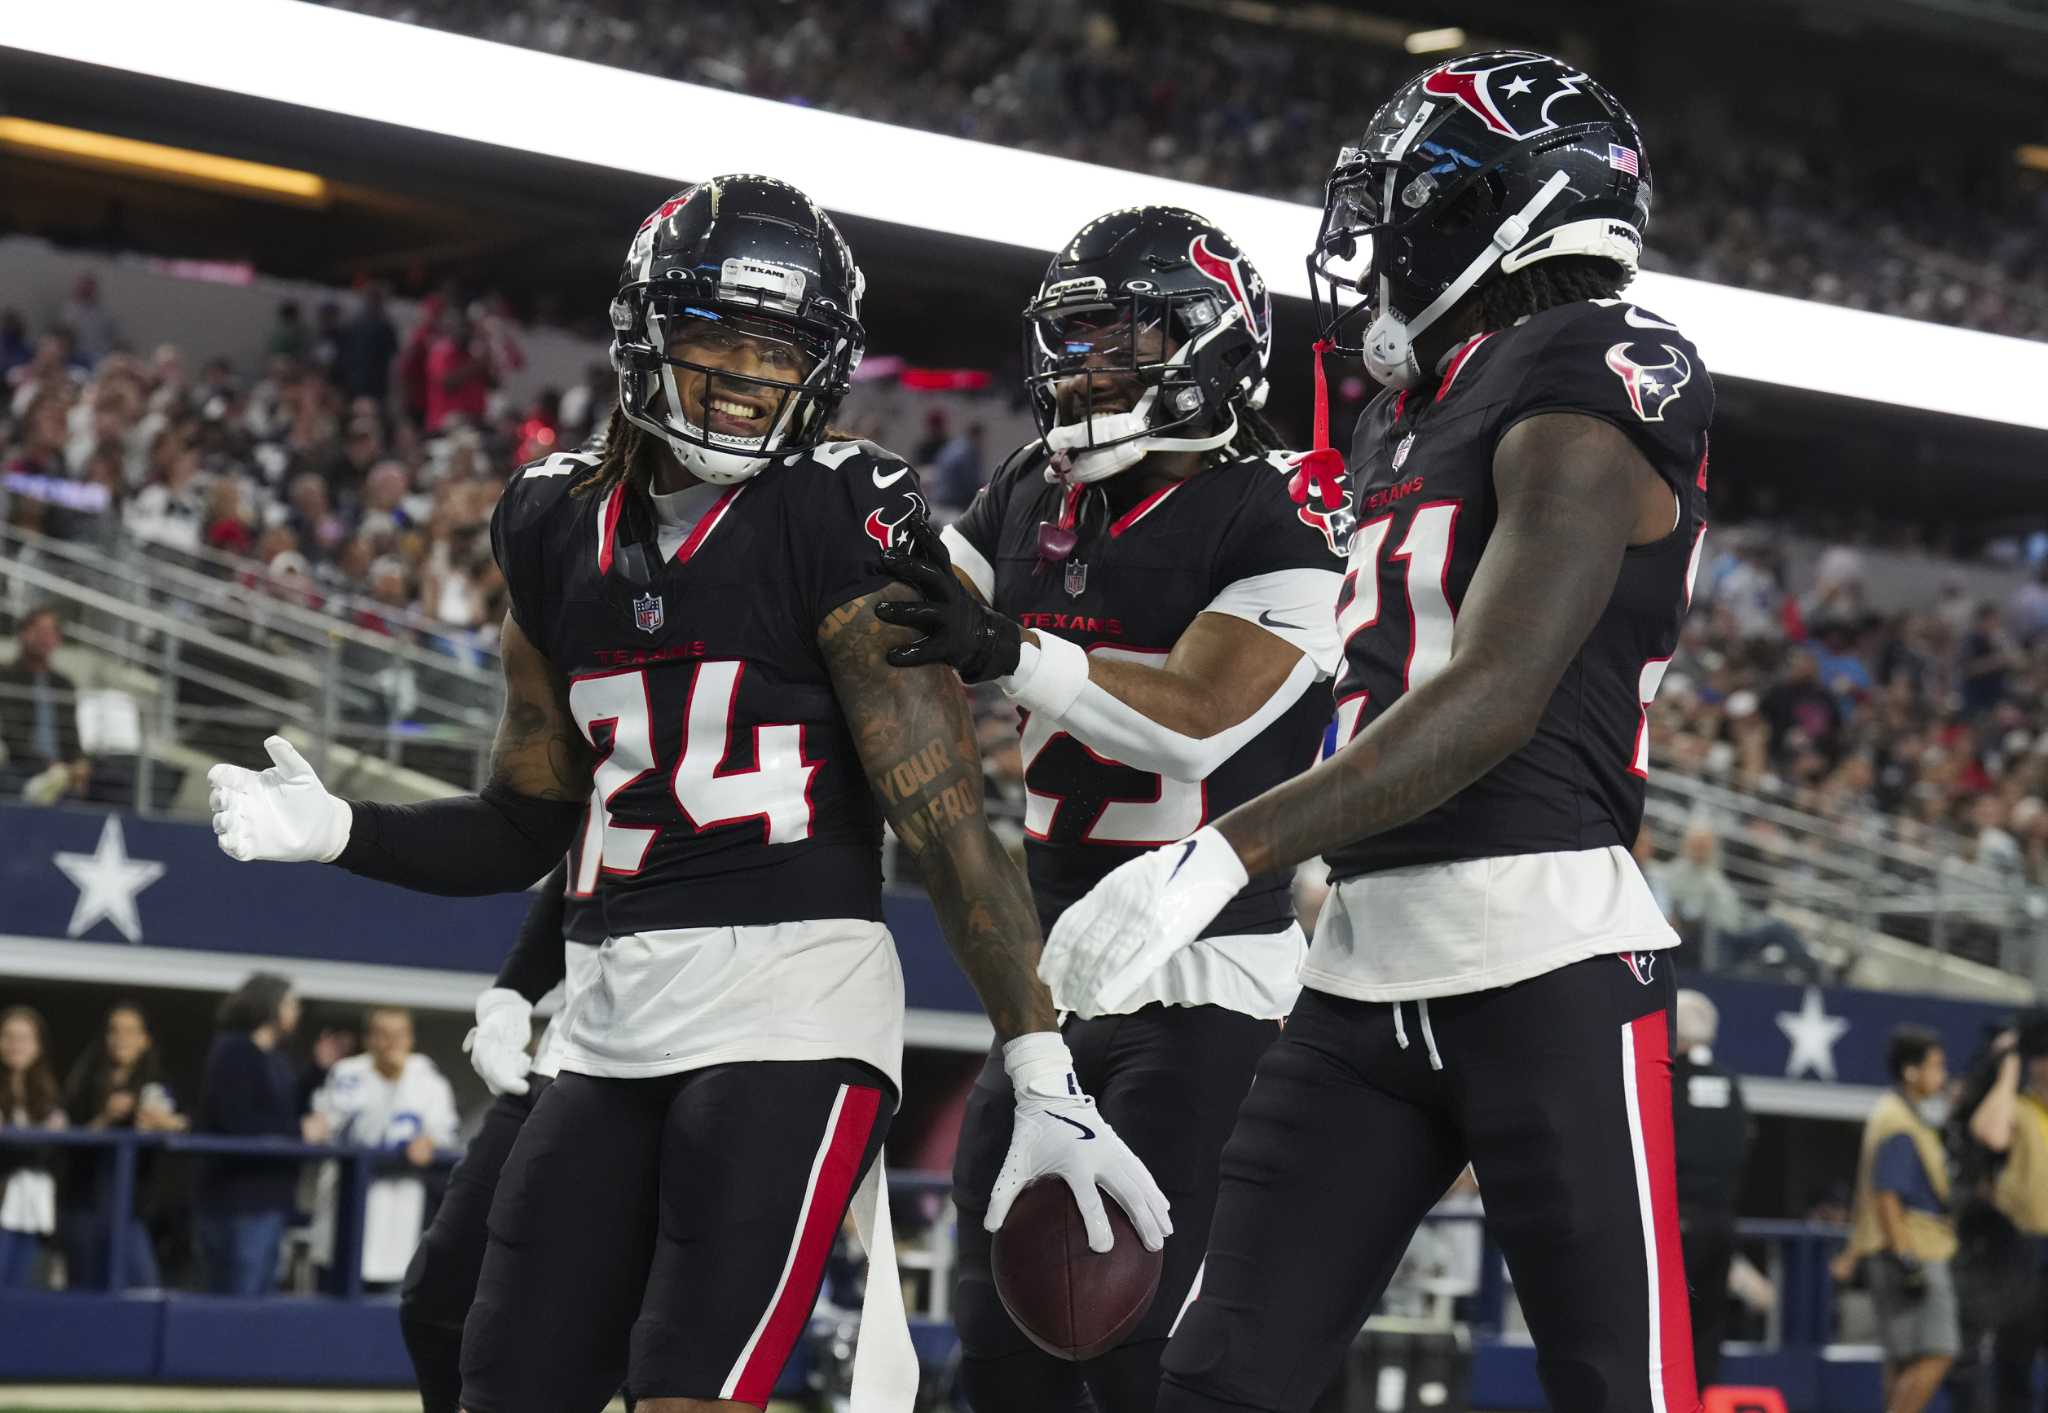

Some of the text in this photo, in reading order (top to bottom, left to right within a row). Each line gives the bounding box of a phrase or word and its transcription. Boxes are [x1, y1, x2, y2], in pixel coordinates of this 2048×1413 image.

[743, 265, 785, 278] TEXANS
[1018, 612, 1123, 634] TEXANS
[569, 658, 826, 878] 24
[877, 737, 952, 805] YOUR
